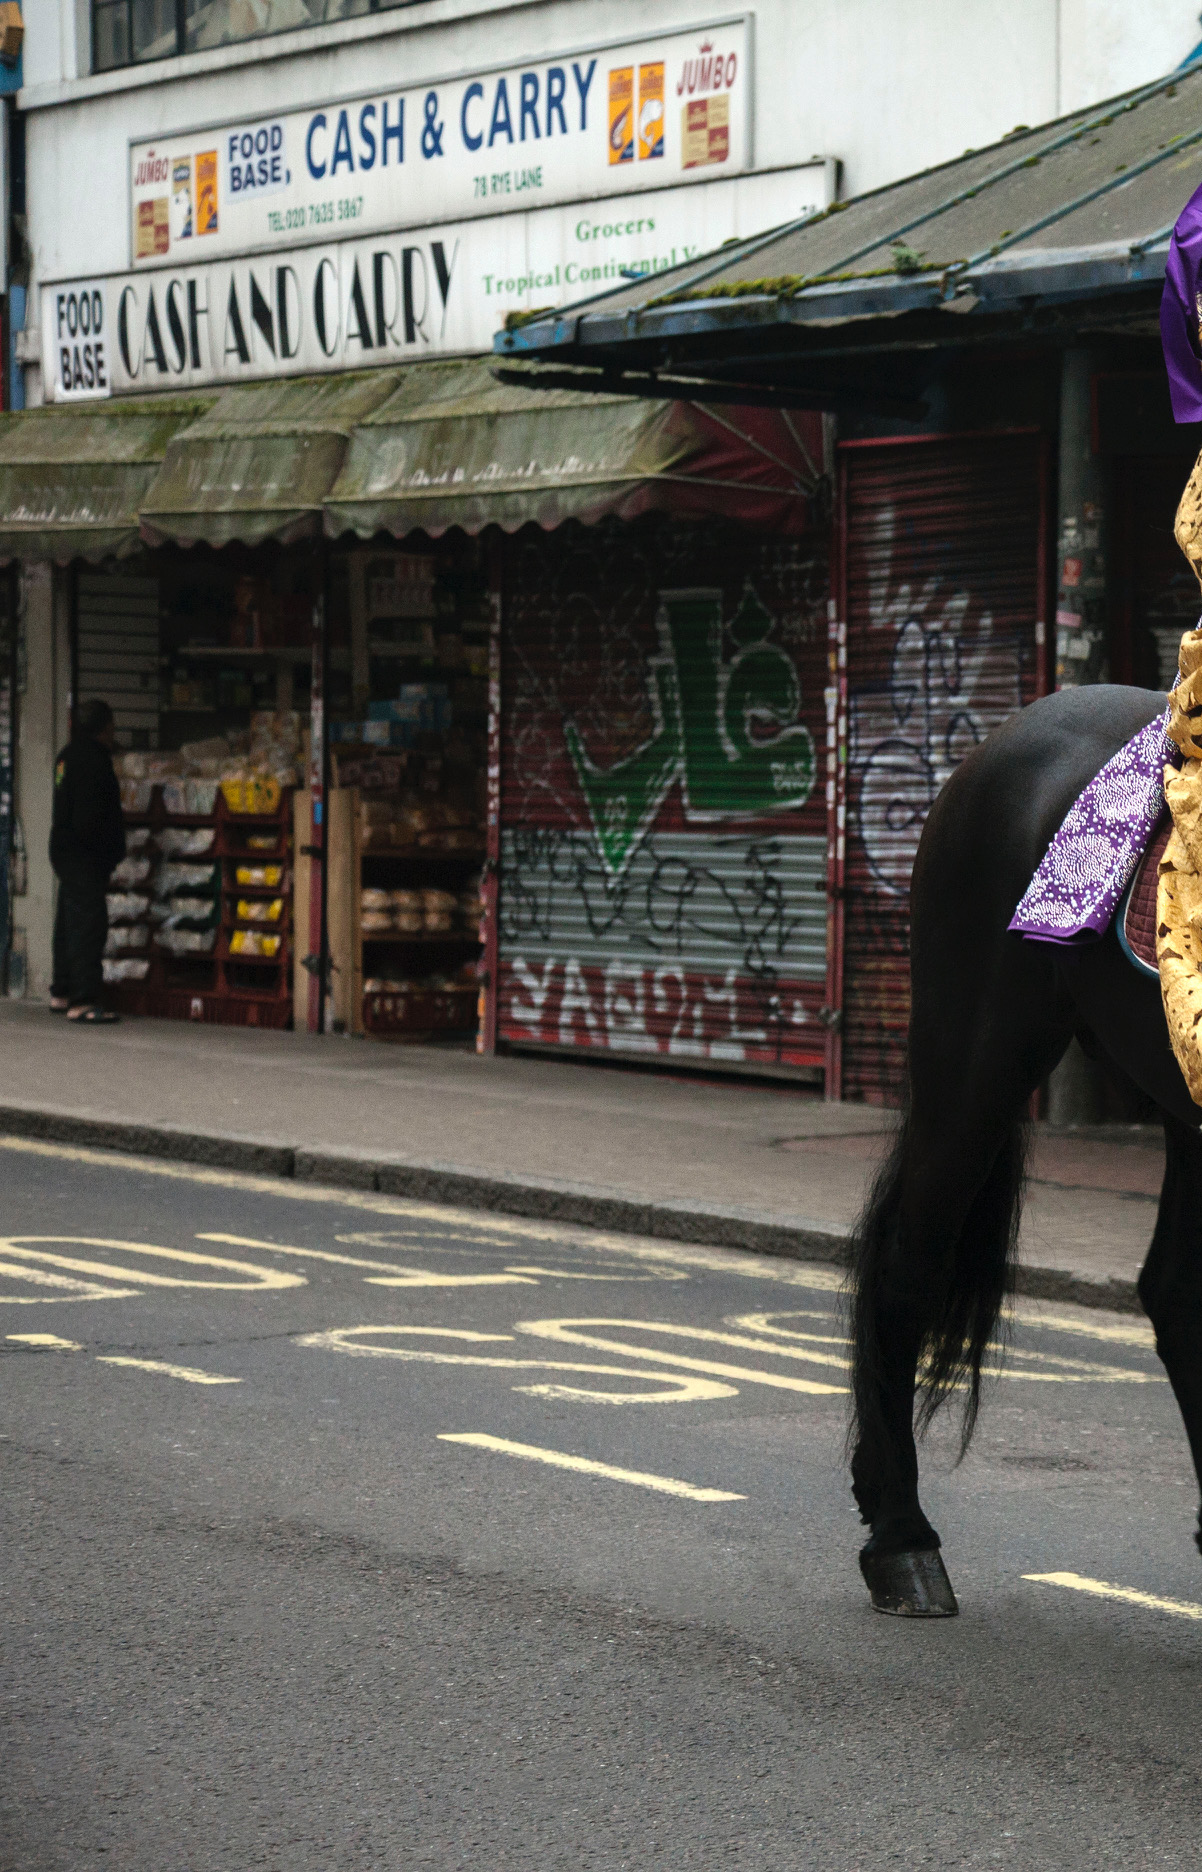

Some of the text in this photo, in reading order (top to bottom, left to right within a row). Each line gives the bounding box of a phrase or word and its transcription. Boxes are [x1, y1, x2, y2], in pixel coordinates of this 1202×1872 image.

[677, 52, 737, 97] JUMBO
[305, 58, 598, 180] CASH & CARRY
[228, 125, 283, 162] FOOD
[134, 157, 169, 186] JUMBO
[473, 165, 542, 199] 78 RYE LANE
[576, 216, 656, 242] Grocers
[482, 265, 560, 296] Tropical
[564, 248, 677, 284] Continental
[57, 289, 103, 340] FOOD
[118, 237, 460, 379] CASH AND CARRY
[60, 343, 107, 391] BASE
